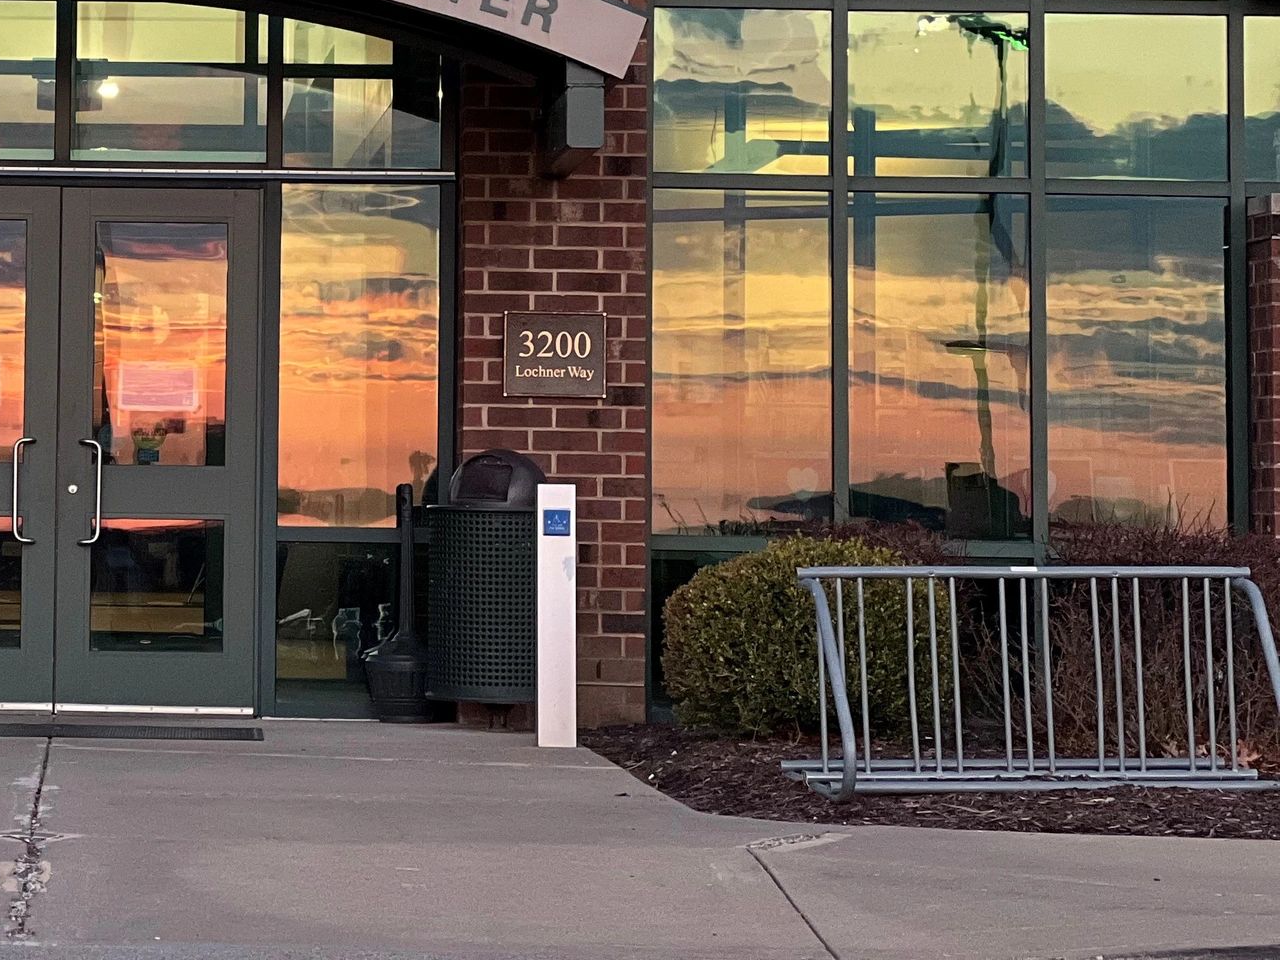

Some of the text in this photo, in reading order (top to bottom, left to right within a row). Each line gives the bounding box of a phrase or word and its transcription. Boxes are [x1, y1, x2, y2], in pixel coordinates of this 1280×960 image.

[519, 330, 591, 358] 3200
[515, 365, 595, 381] Lochner Way
